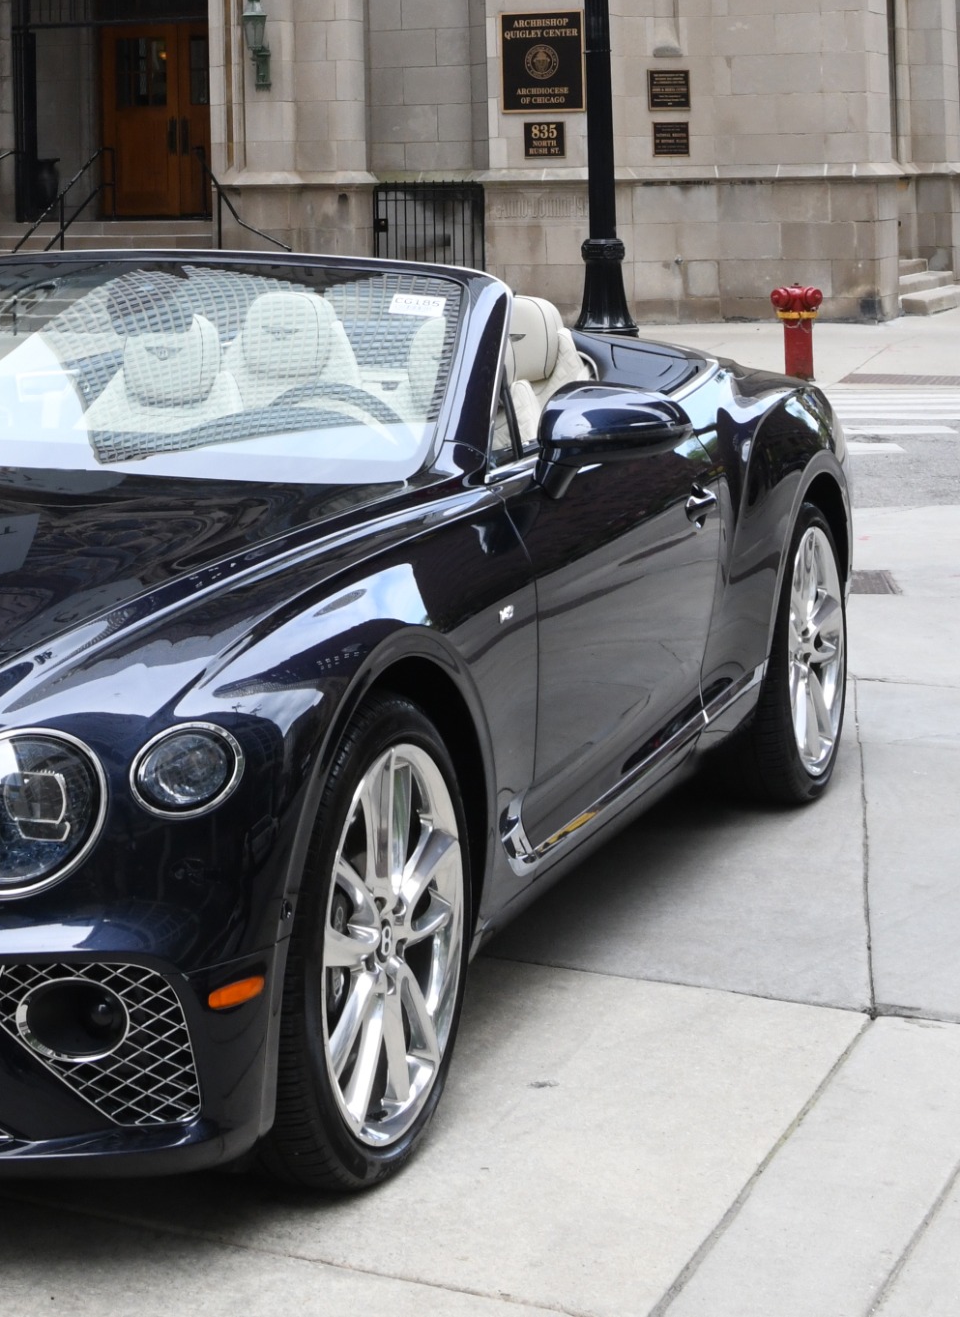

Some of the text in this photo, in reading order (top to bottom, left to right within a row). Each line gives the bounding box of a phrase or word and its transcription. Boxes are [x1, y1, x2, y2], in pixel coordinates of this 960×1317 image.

[513, 18, 569, 28] ARCHBISHOP
[504, 28, 578, 40] QUIGLEY CENTER
[516, 87, 569, 95] ARCHDIOCESE
[531, 96, 565, 104] CHICAGO
[531, 124, 557, 139] 835
